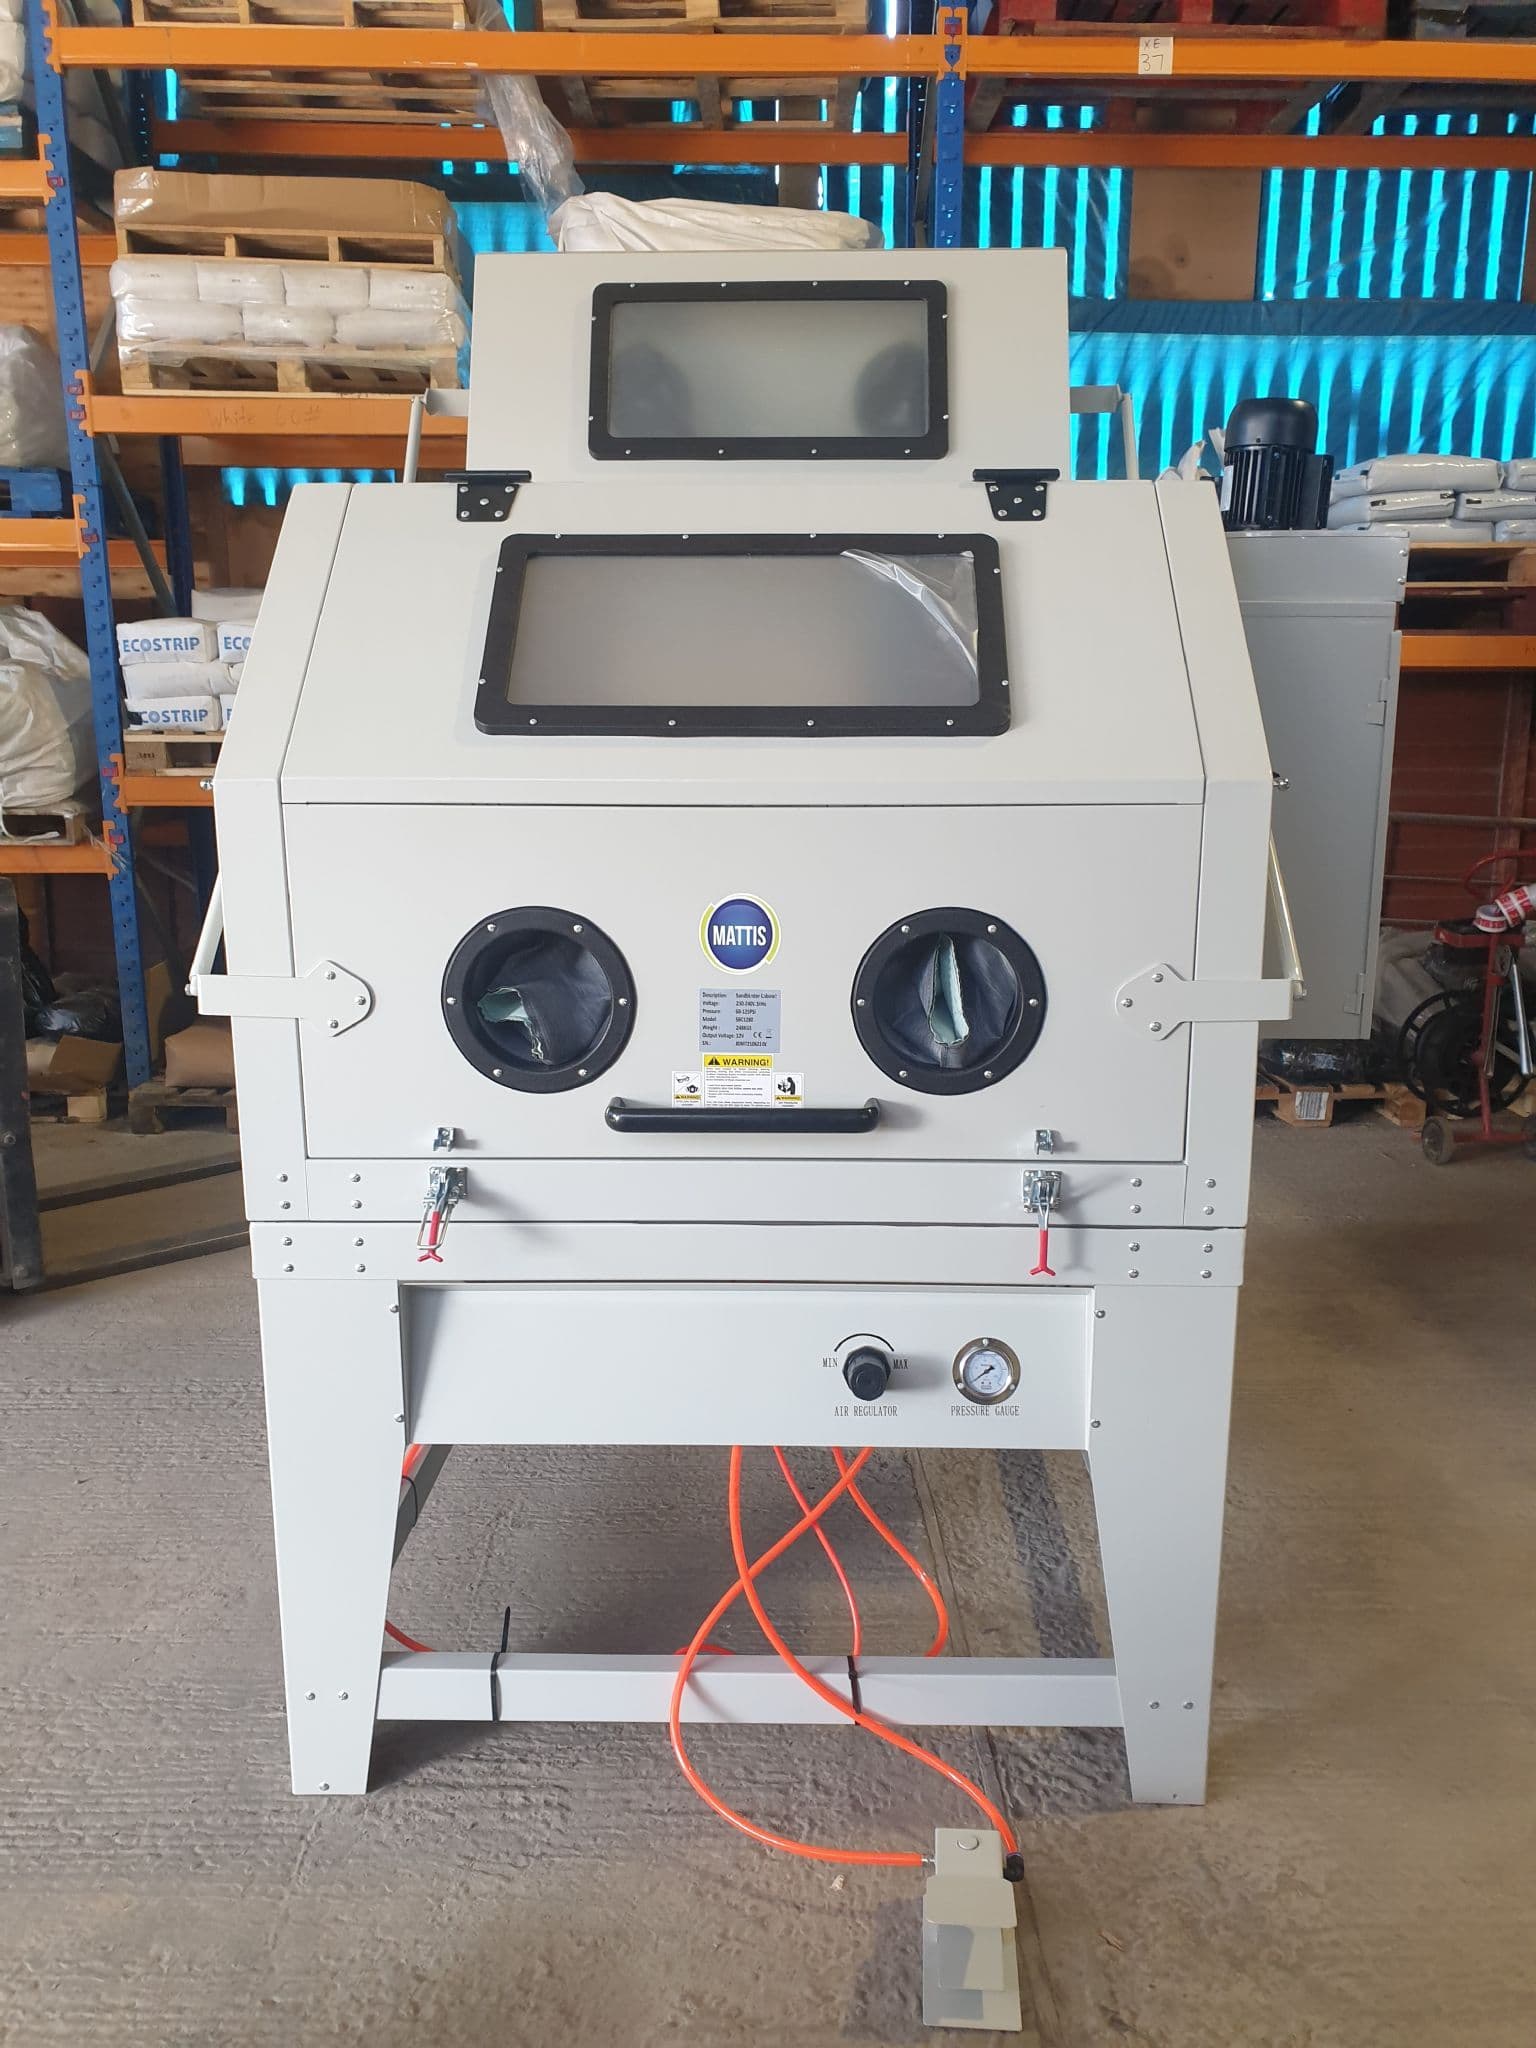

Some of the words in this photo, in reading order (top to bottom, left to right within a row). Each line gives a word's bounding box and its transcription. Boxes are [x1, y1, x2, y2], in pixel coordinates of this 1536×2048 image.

[1140, 53, 1164, 72] 37
[122, 636, 200, 652] ECOSTRIP
[140, 709, 209, 724] COSTRIP
[712, 925, 767, 946] MATTIS
[722, 1058, 769, 1067] WARNING!
[822, 1357, 838, 1368] MIN
[893, 1358, 909, 1370] MAX
[834, 1406, 849, 1417] AIR
[853, 1406, 898, 1417] REGULATOR
[951, 1406, 990, 1416] PRESSURE
[995, 1406, 1020, 1416] GAUGE
